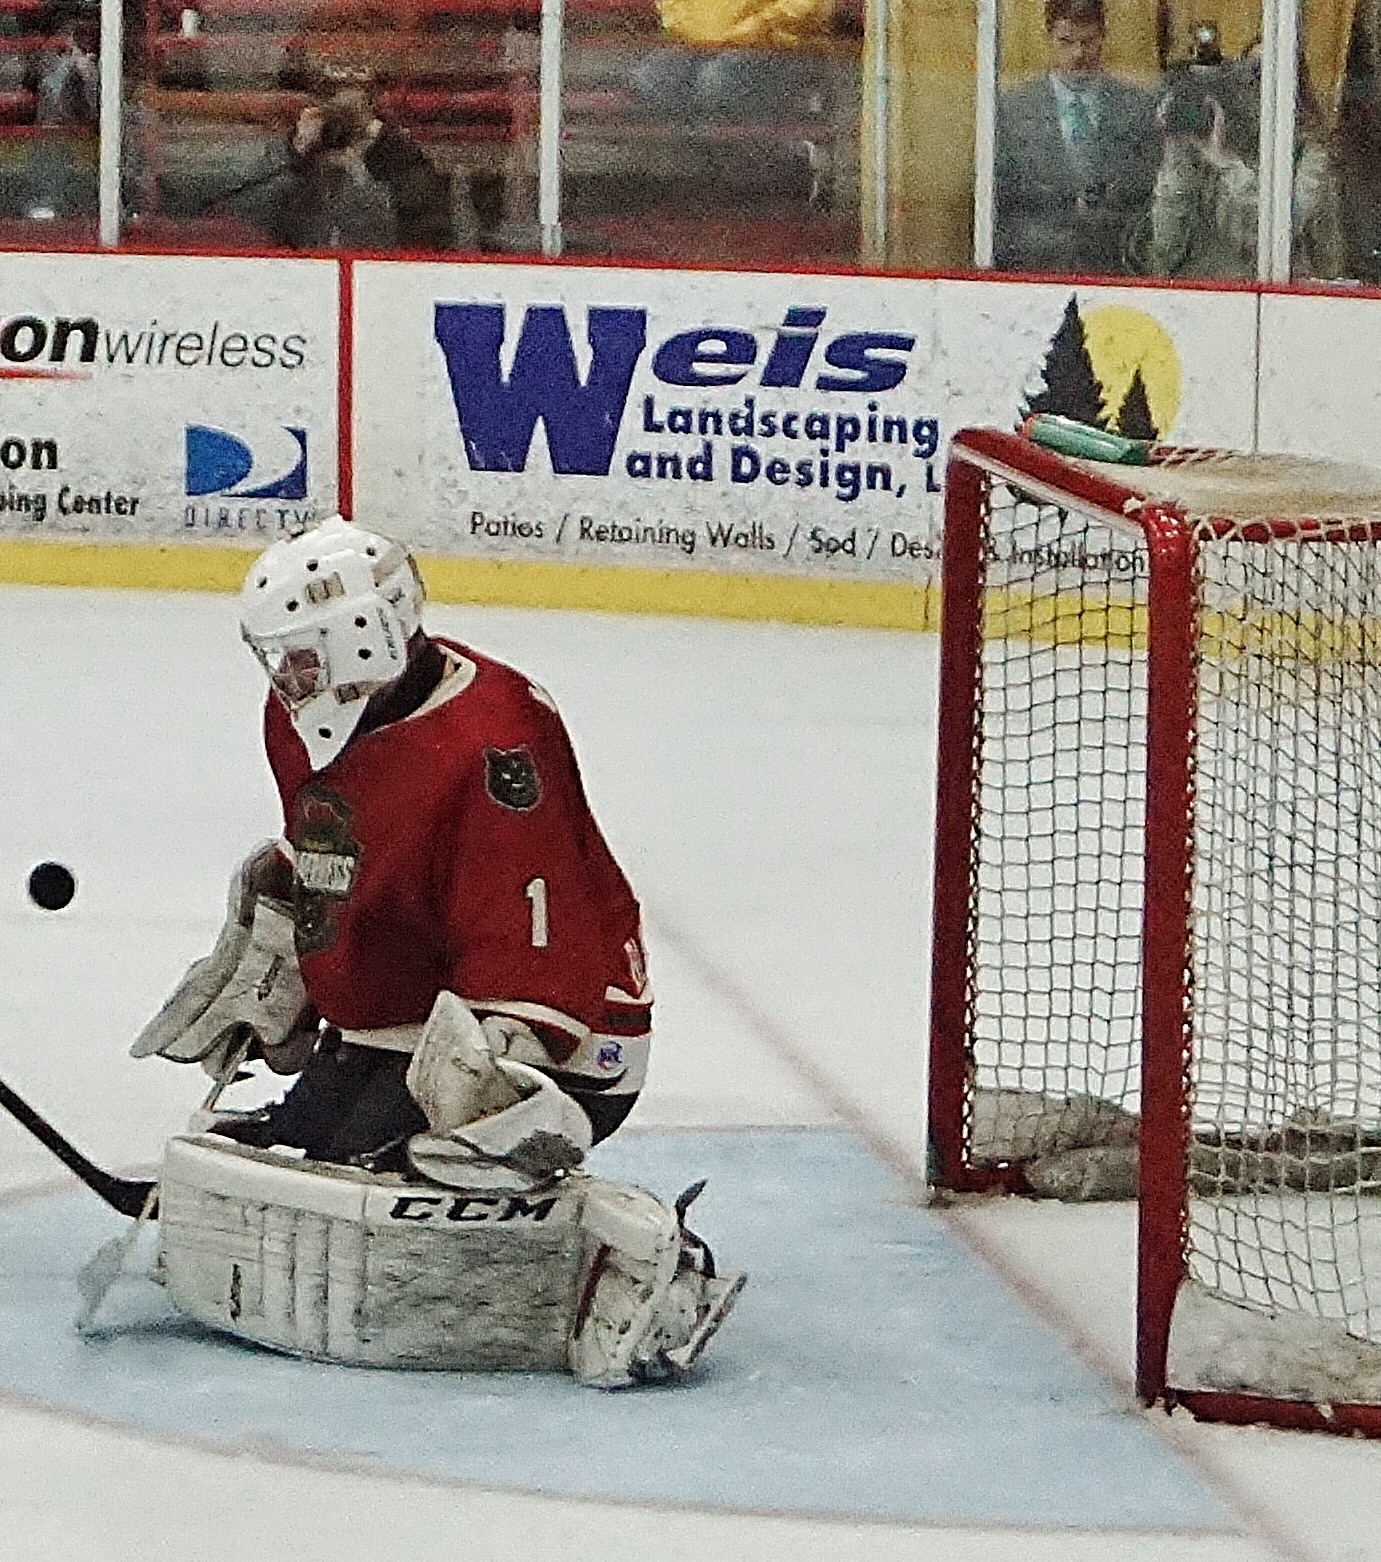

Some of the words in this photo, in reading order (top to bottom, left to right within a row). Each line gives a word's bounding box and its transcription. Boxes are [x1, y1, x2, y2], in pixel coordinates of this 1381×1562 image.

[433, 302, 916, 476] Weis
[643, 394, 940, 457] Landscaping
[626, 441, 714, 482] and
[730, 445, 906, 501] Design,
[58, 486, 141, 517] Center
[470, 511, 544, 540] Patios
[580, 515, 698, 555] Retaining
[706, 521, 776, 552] Walls
[809, 528, 857, 558] Sod
[525, 877, 550, 948] 1
[389, 1196, 558, 1222] CCM
